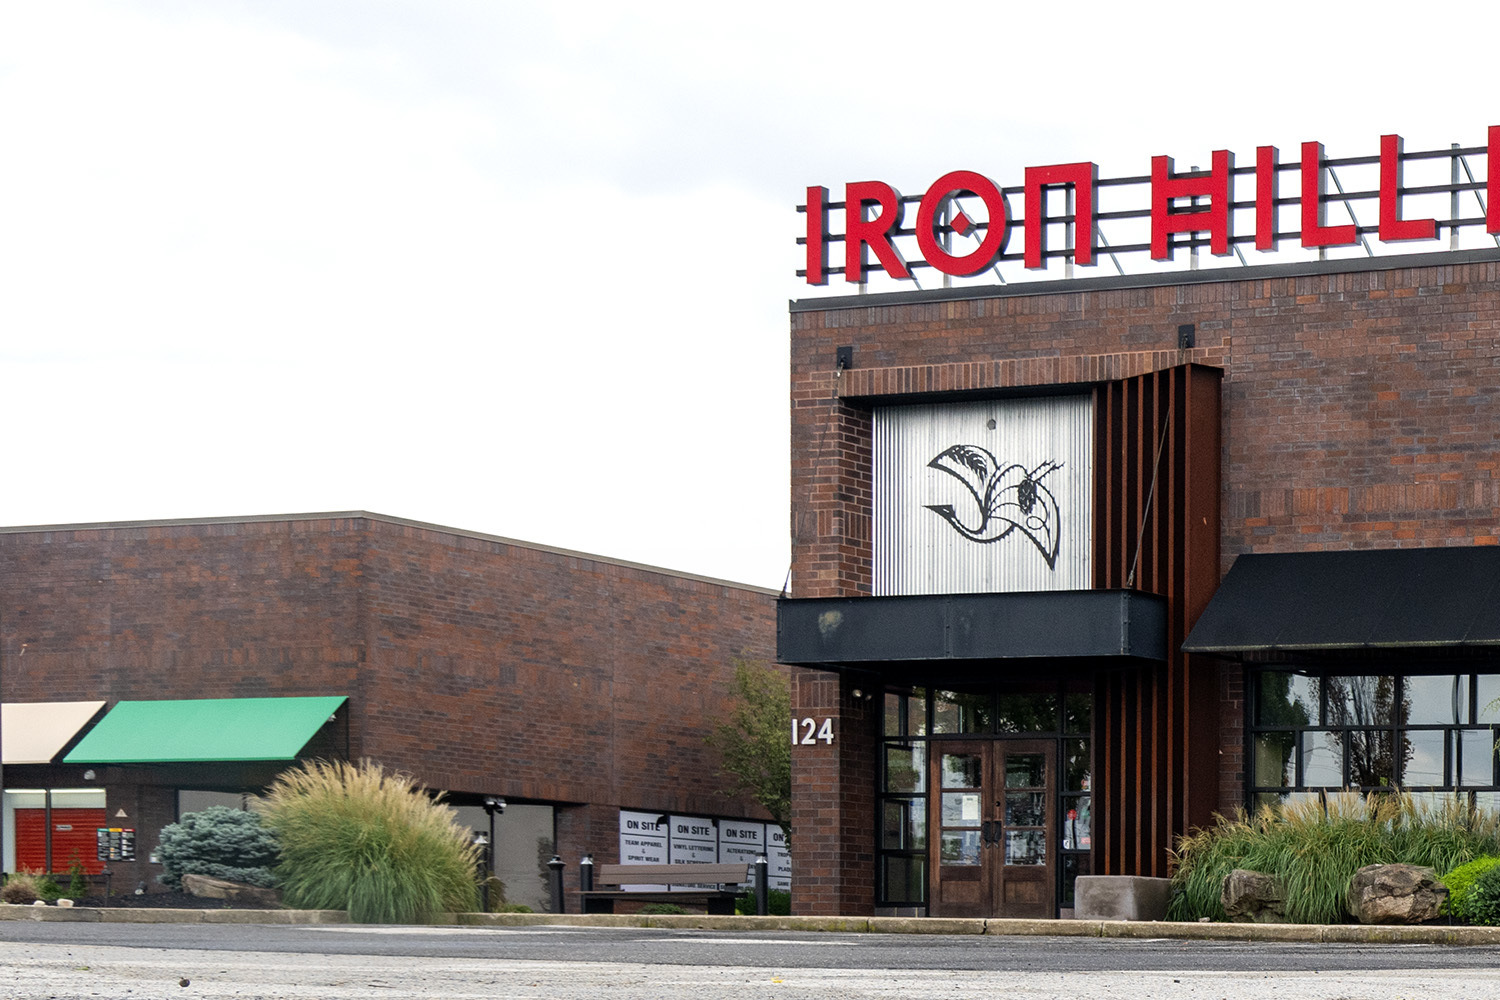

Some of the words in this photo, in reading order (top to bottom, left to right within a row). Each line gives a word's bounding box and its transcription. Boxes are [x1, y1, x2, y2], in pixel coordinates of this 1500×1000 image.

[806, 161, 1098, 286] IRON
[1150, 133, 1440, 262] HILL
[792, 717, 835, 746] 124
[627, 820, 639, 830] ON
[677, 824, 689, 834] ON
[691, 825, 711, 836] SITE
[726, 828, 737, 838] ON
[739, 830, 757, 839] SITE
[773, 832, 784, 842] ON
[640, 840, 663, 848] APPAREL
